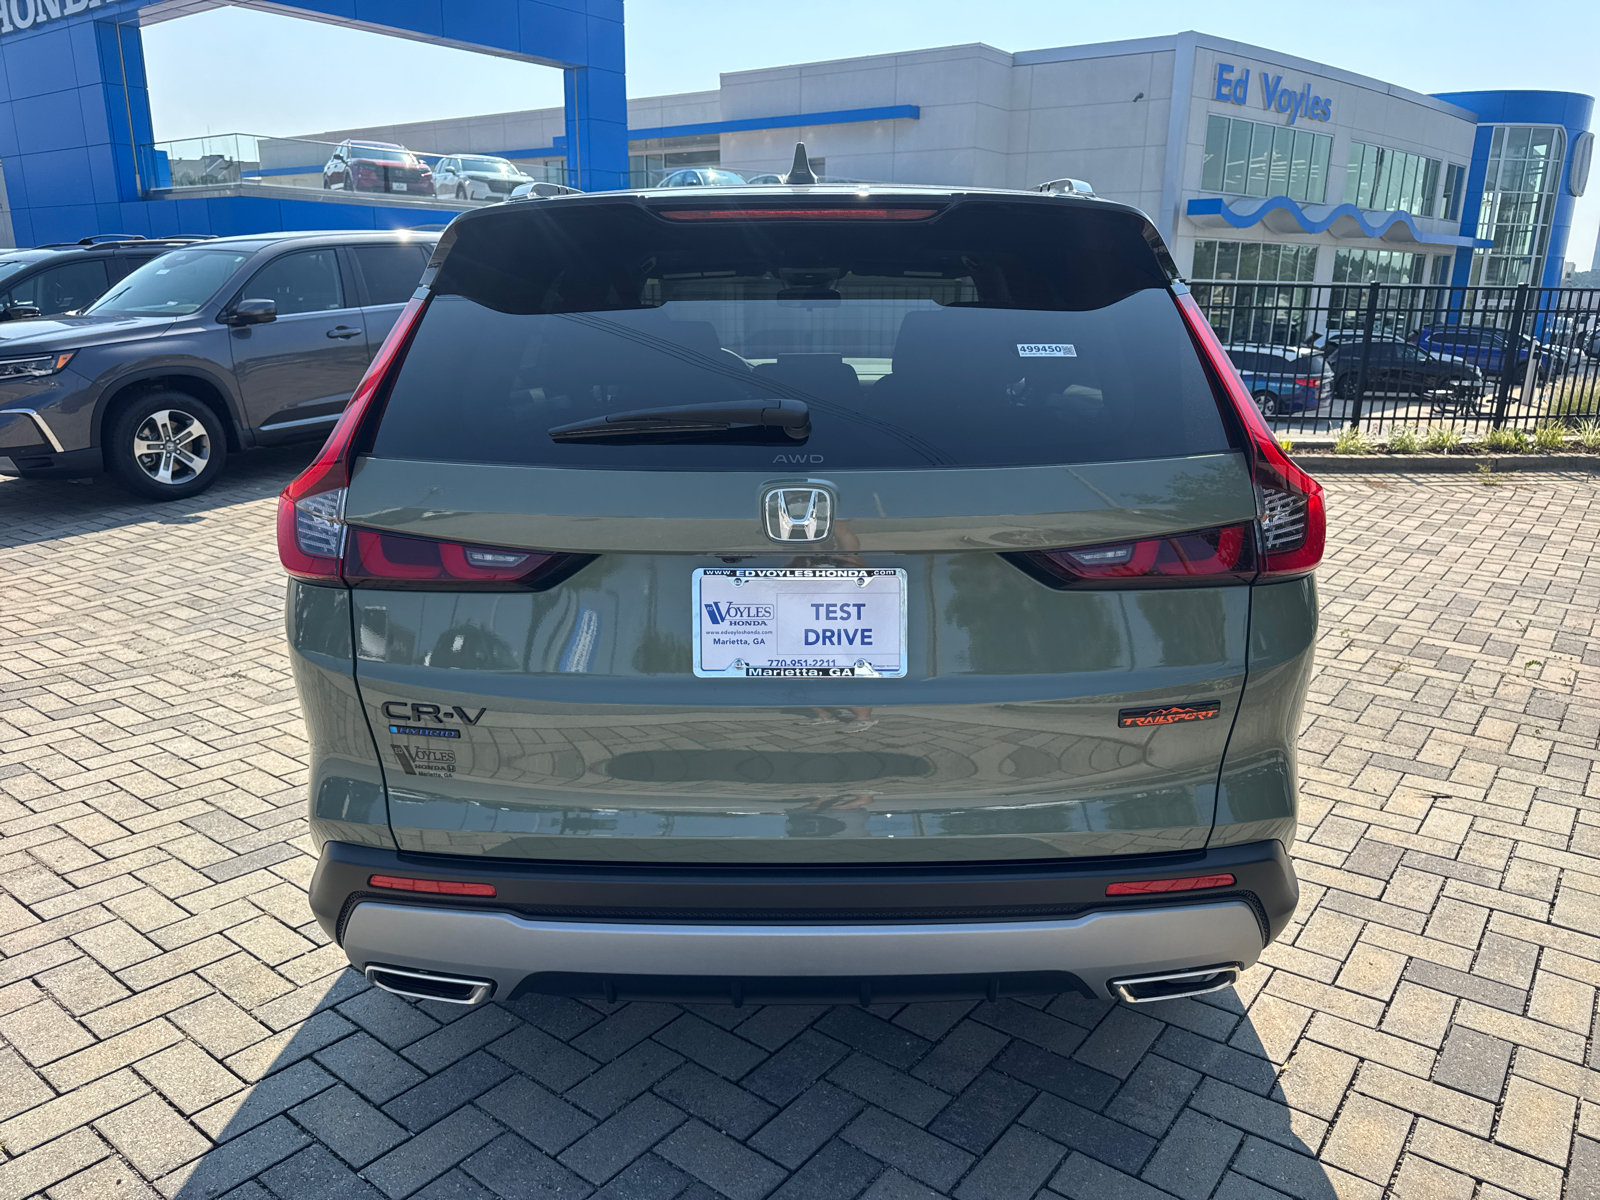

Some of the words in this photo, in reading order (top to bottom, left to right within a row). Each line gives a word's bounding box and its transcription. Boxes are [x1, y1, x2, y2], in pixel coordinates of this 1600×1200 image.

[1214, 63, 1250, 105] Ed
[1260, 72, 1332, 125] Voyles
[772, 454, 824, 464] AWD
[810, 603, 866, 621] TEST
[713, 638, 750, 646] Marietta,
[804, 628, 873, 646] DRIVE
[767, 659, 836, 667] 770-951-2211
[748, 668, 823, 676] Marietta,
[828, 668, 853, 676] GA
[381, 701, 487, 726] CR-V
[1123, 710, 1218, 726] TRAILSPORT
[399, 727, 455, 737] HYBRID
